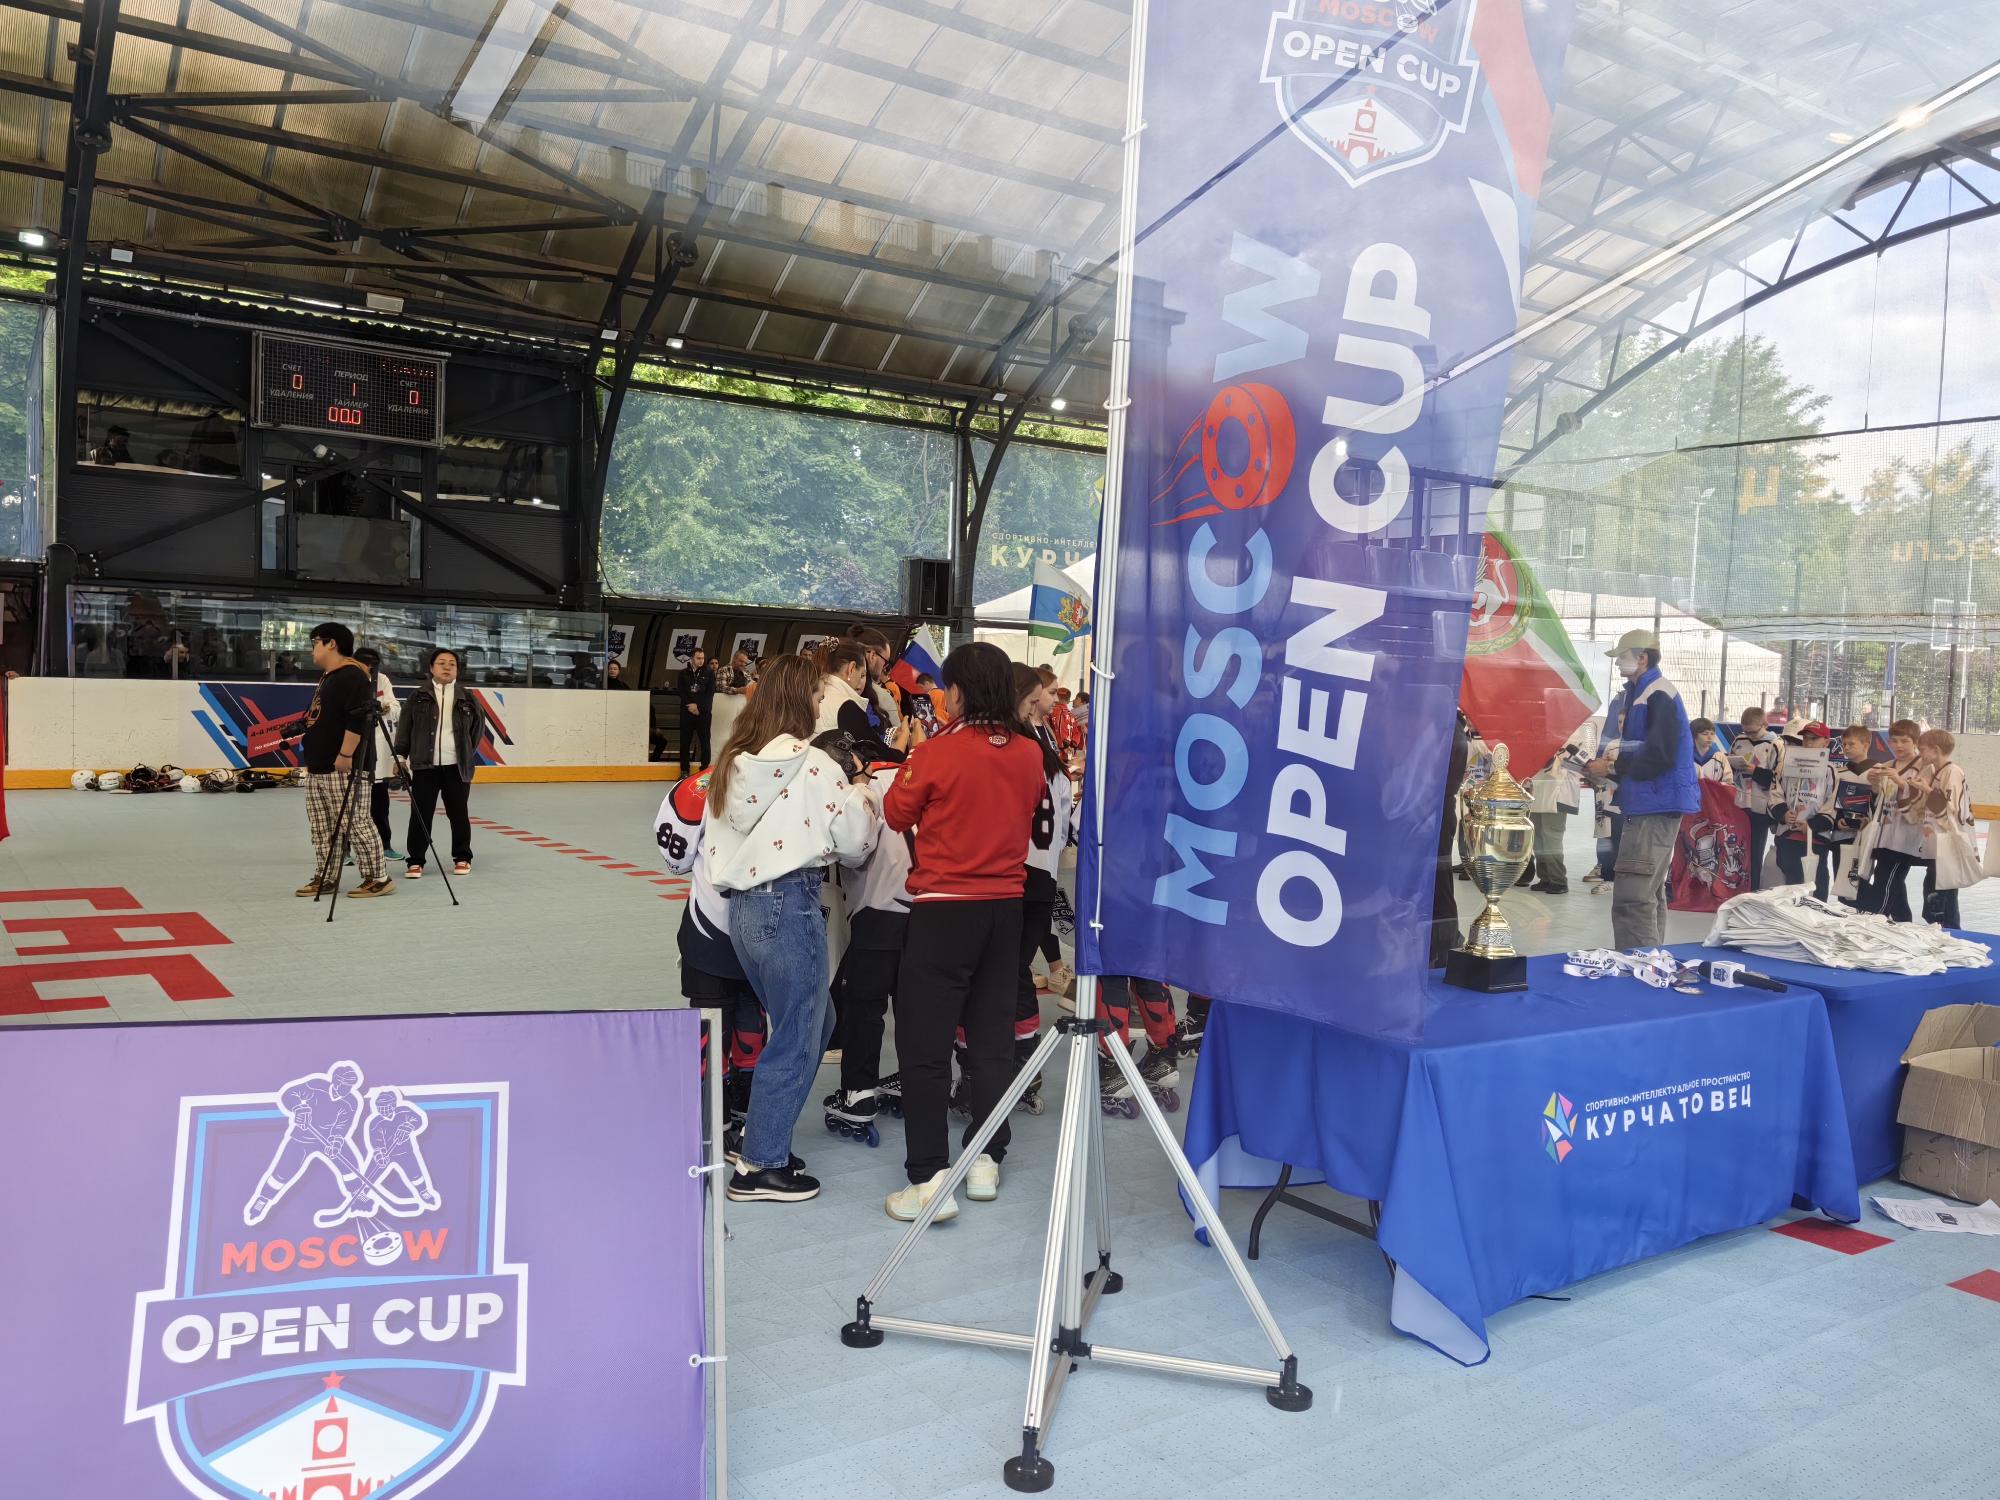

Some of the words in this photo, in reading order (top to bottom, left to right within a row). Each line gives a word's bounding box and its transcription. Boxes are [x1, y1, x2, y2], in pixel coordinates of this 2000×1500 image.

[1282, 30, 1387, 74] OPEN
[1396, 54, 1461, 98] CUP
[282, 363, 302, 372] СЧЕТ
[292, 374, 303, 389] 0
[333, 370, 369, 381] ПЕРИОД
[399, 380, 418, 388] СЧЕТ
[1309, 242, 1431, 534] CUP
[269, 388, 314, 400] УДАЛЕНИЯ
[409, 390, 419, 404] 0
[333, 398, 369, 409] ТАЙМЕР
[387, 404, 429, 415] УДАЛЕНИЯ
[1256, 576, 1388, 948] OPEN
[656, 822, 688, 860] 88
[1583, 958, 1601, 966] CUP
[1585, 1079, 1700, 1112] СПОРТИВНО-ИНТЕЛЛЕКТУАЛЬНОЕ
[1701, 1071, 1751, 1087] ПРОСТРАНСТВО
[1586, 1084, 1752, 1141] КУРЧАТОВЕЦ
[220, 1227, 449, 1276] MOSCOW
[161, 1303, 350, 1364] OPEN
[372, 1292, 504, 1346] CUP
